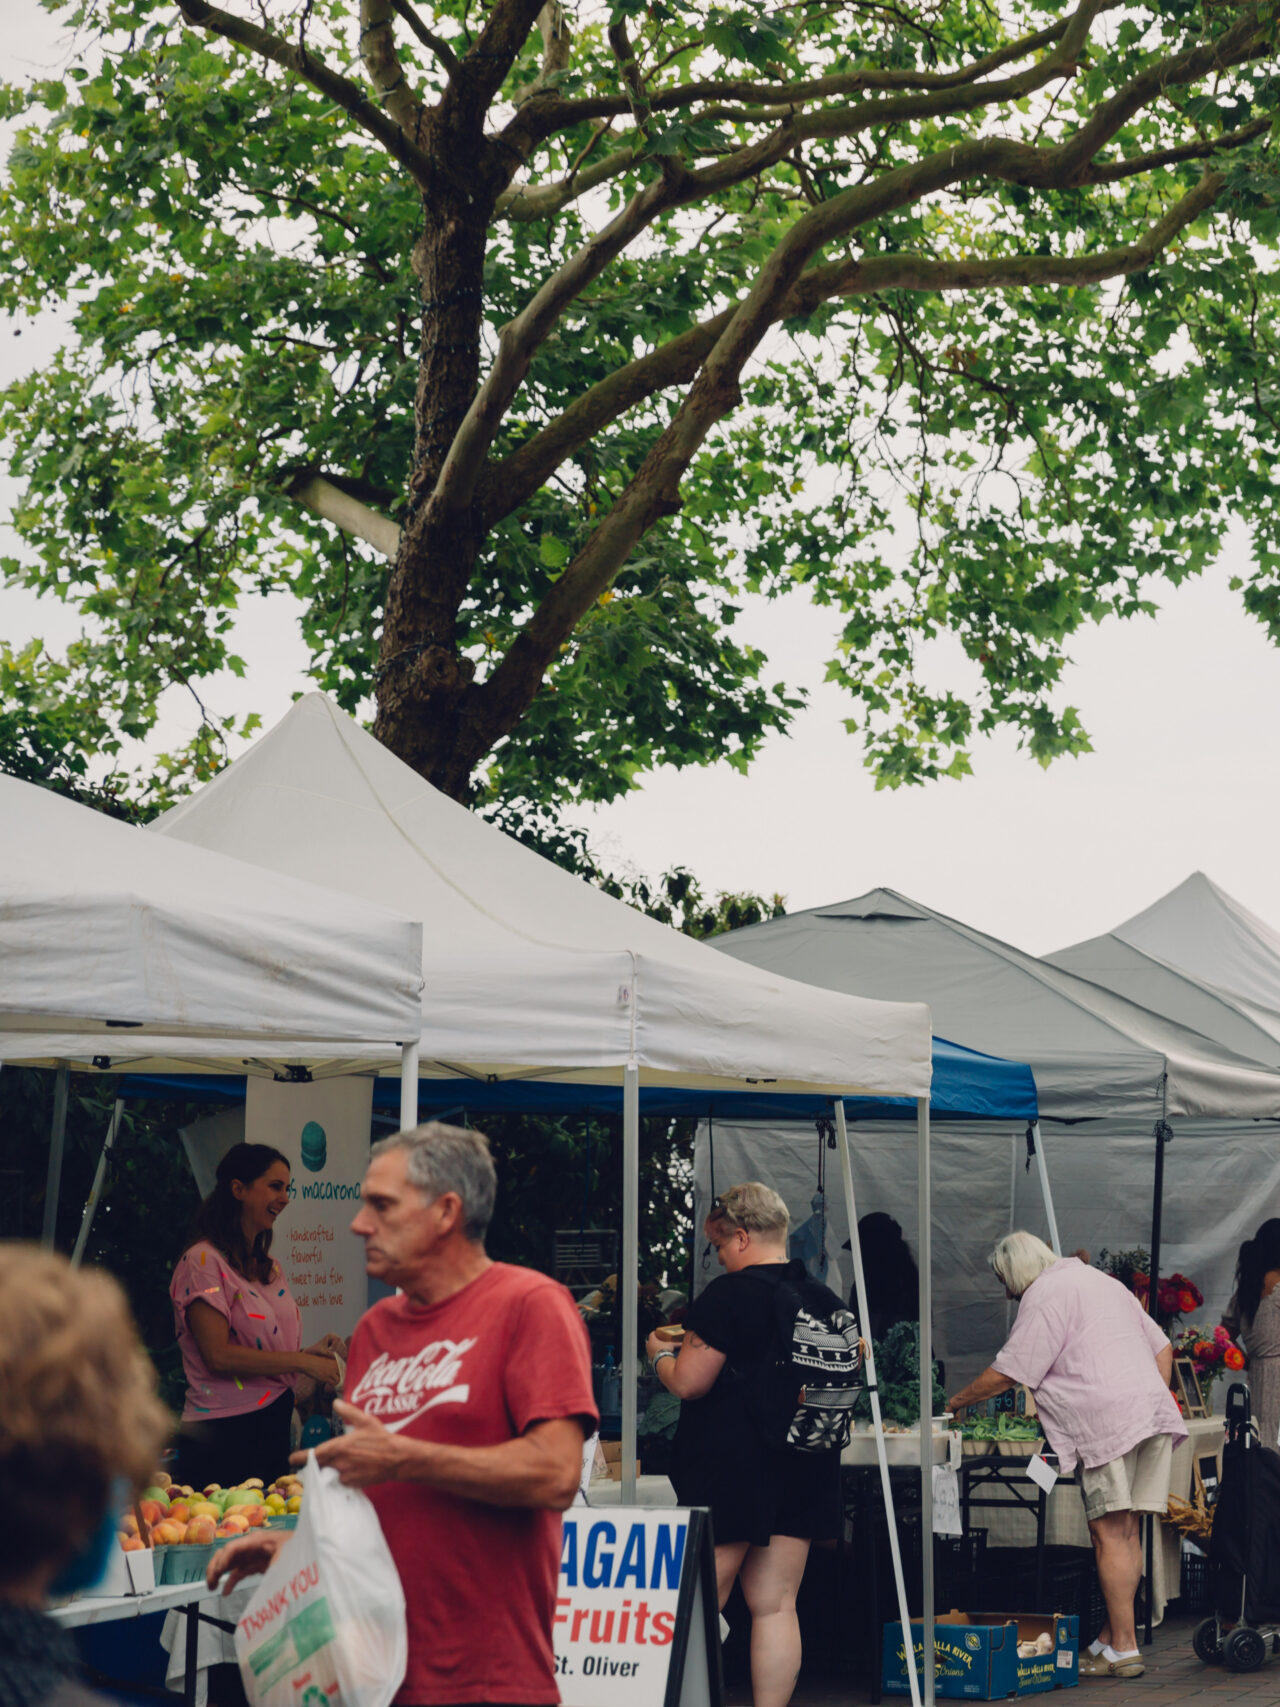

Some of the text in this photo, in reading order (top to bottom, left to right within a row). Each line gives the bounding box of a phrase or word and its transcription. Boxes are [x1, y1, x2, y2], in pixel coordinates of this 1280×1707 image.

[238, 1562, 320, 1641] THANK YOU
[583, 1655, 640, 1677] Oliver
[952, 1646, 974, 1670] RIVER
